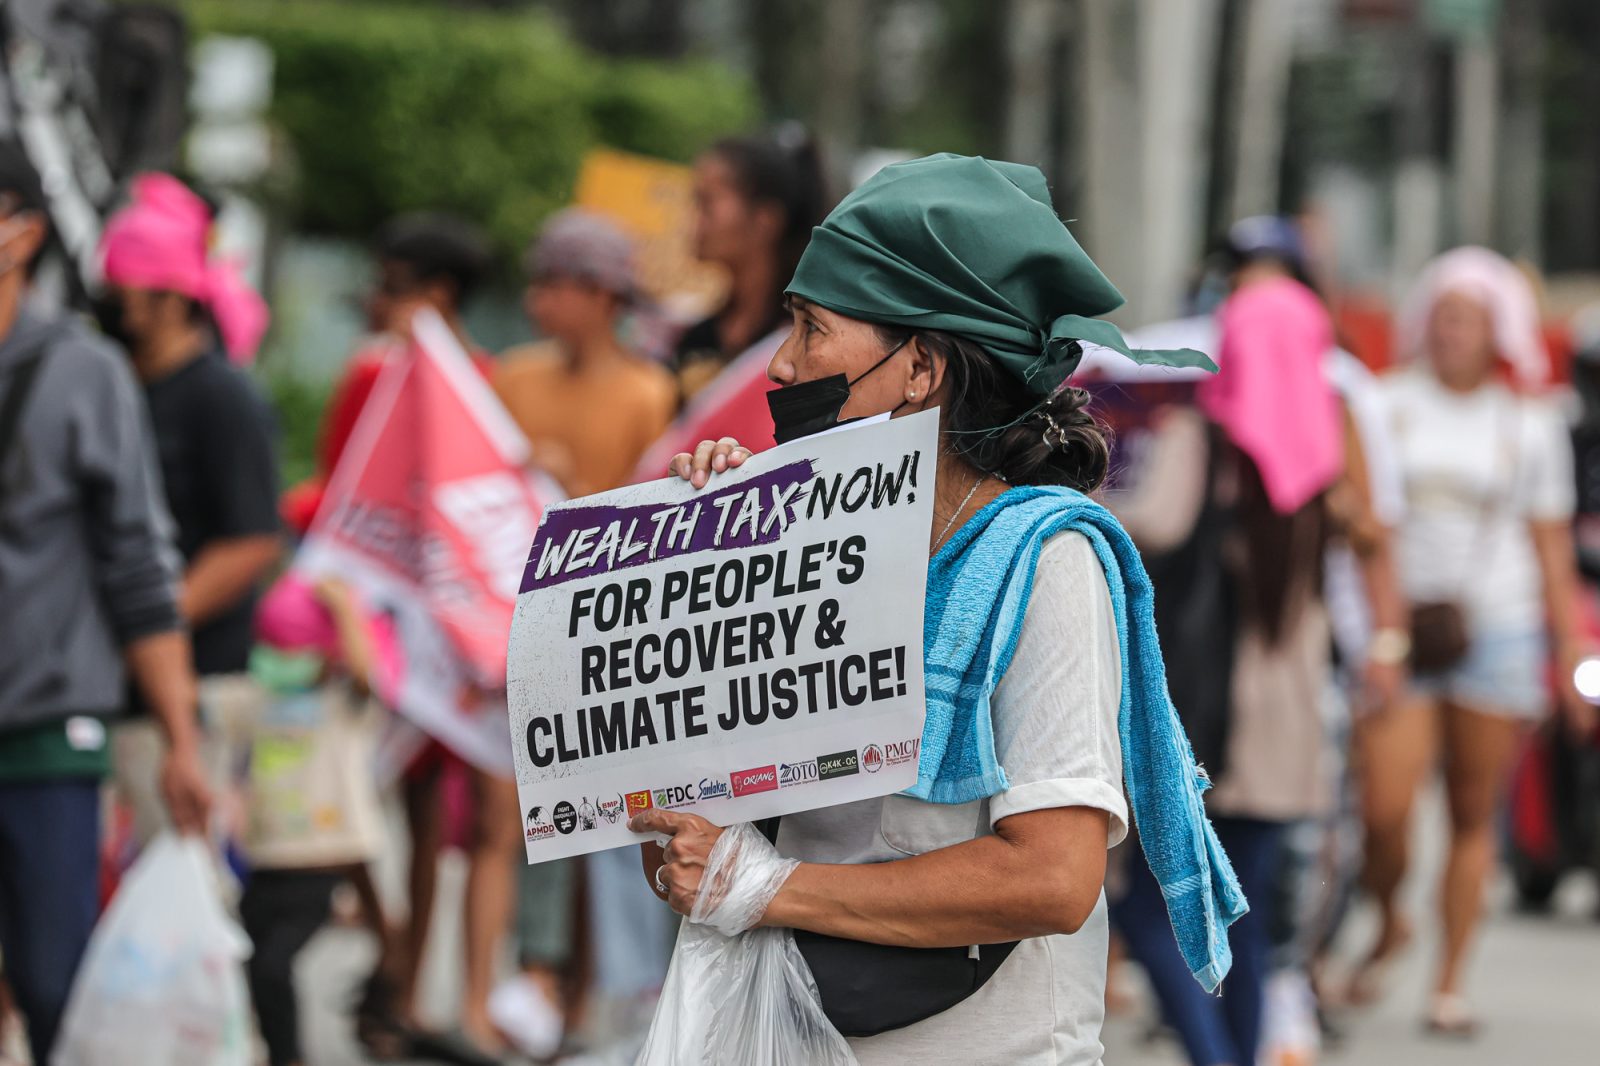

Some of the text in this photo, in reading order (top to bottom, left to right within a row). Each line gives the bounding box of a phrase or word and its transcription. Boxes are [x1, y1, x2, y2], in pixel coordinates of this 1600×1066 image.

[535, 501, 703, 580] WEALTH
[713, 481, 801, 547] TAX
[806, 450, 920, 520] NOW!
[568, 534, 867, 638] FOR PEOPLE'S
[581, 598, 847, 696] RECOVERY &
[526, 645, 907, 768] CLIMATE JUSTICE!
[602, 800, 618, 809] BMP
[666, 784, 694, 804] FDC
[743, 771, 775, 786] ORIANG
[527, 824, 555, 837] APMDD
